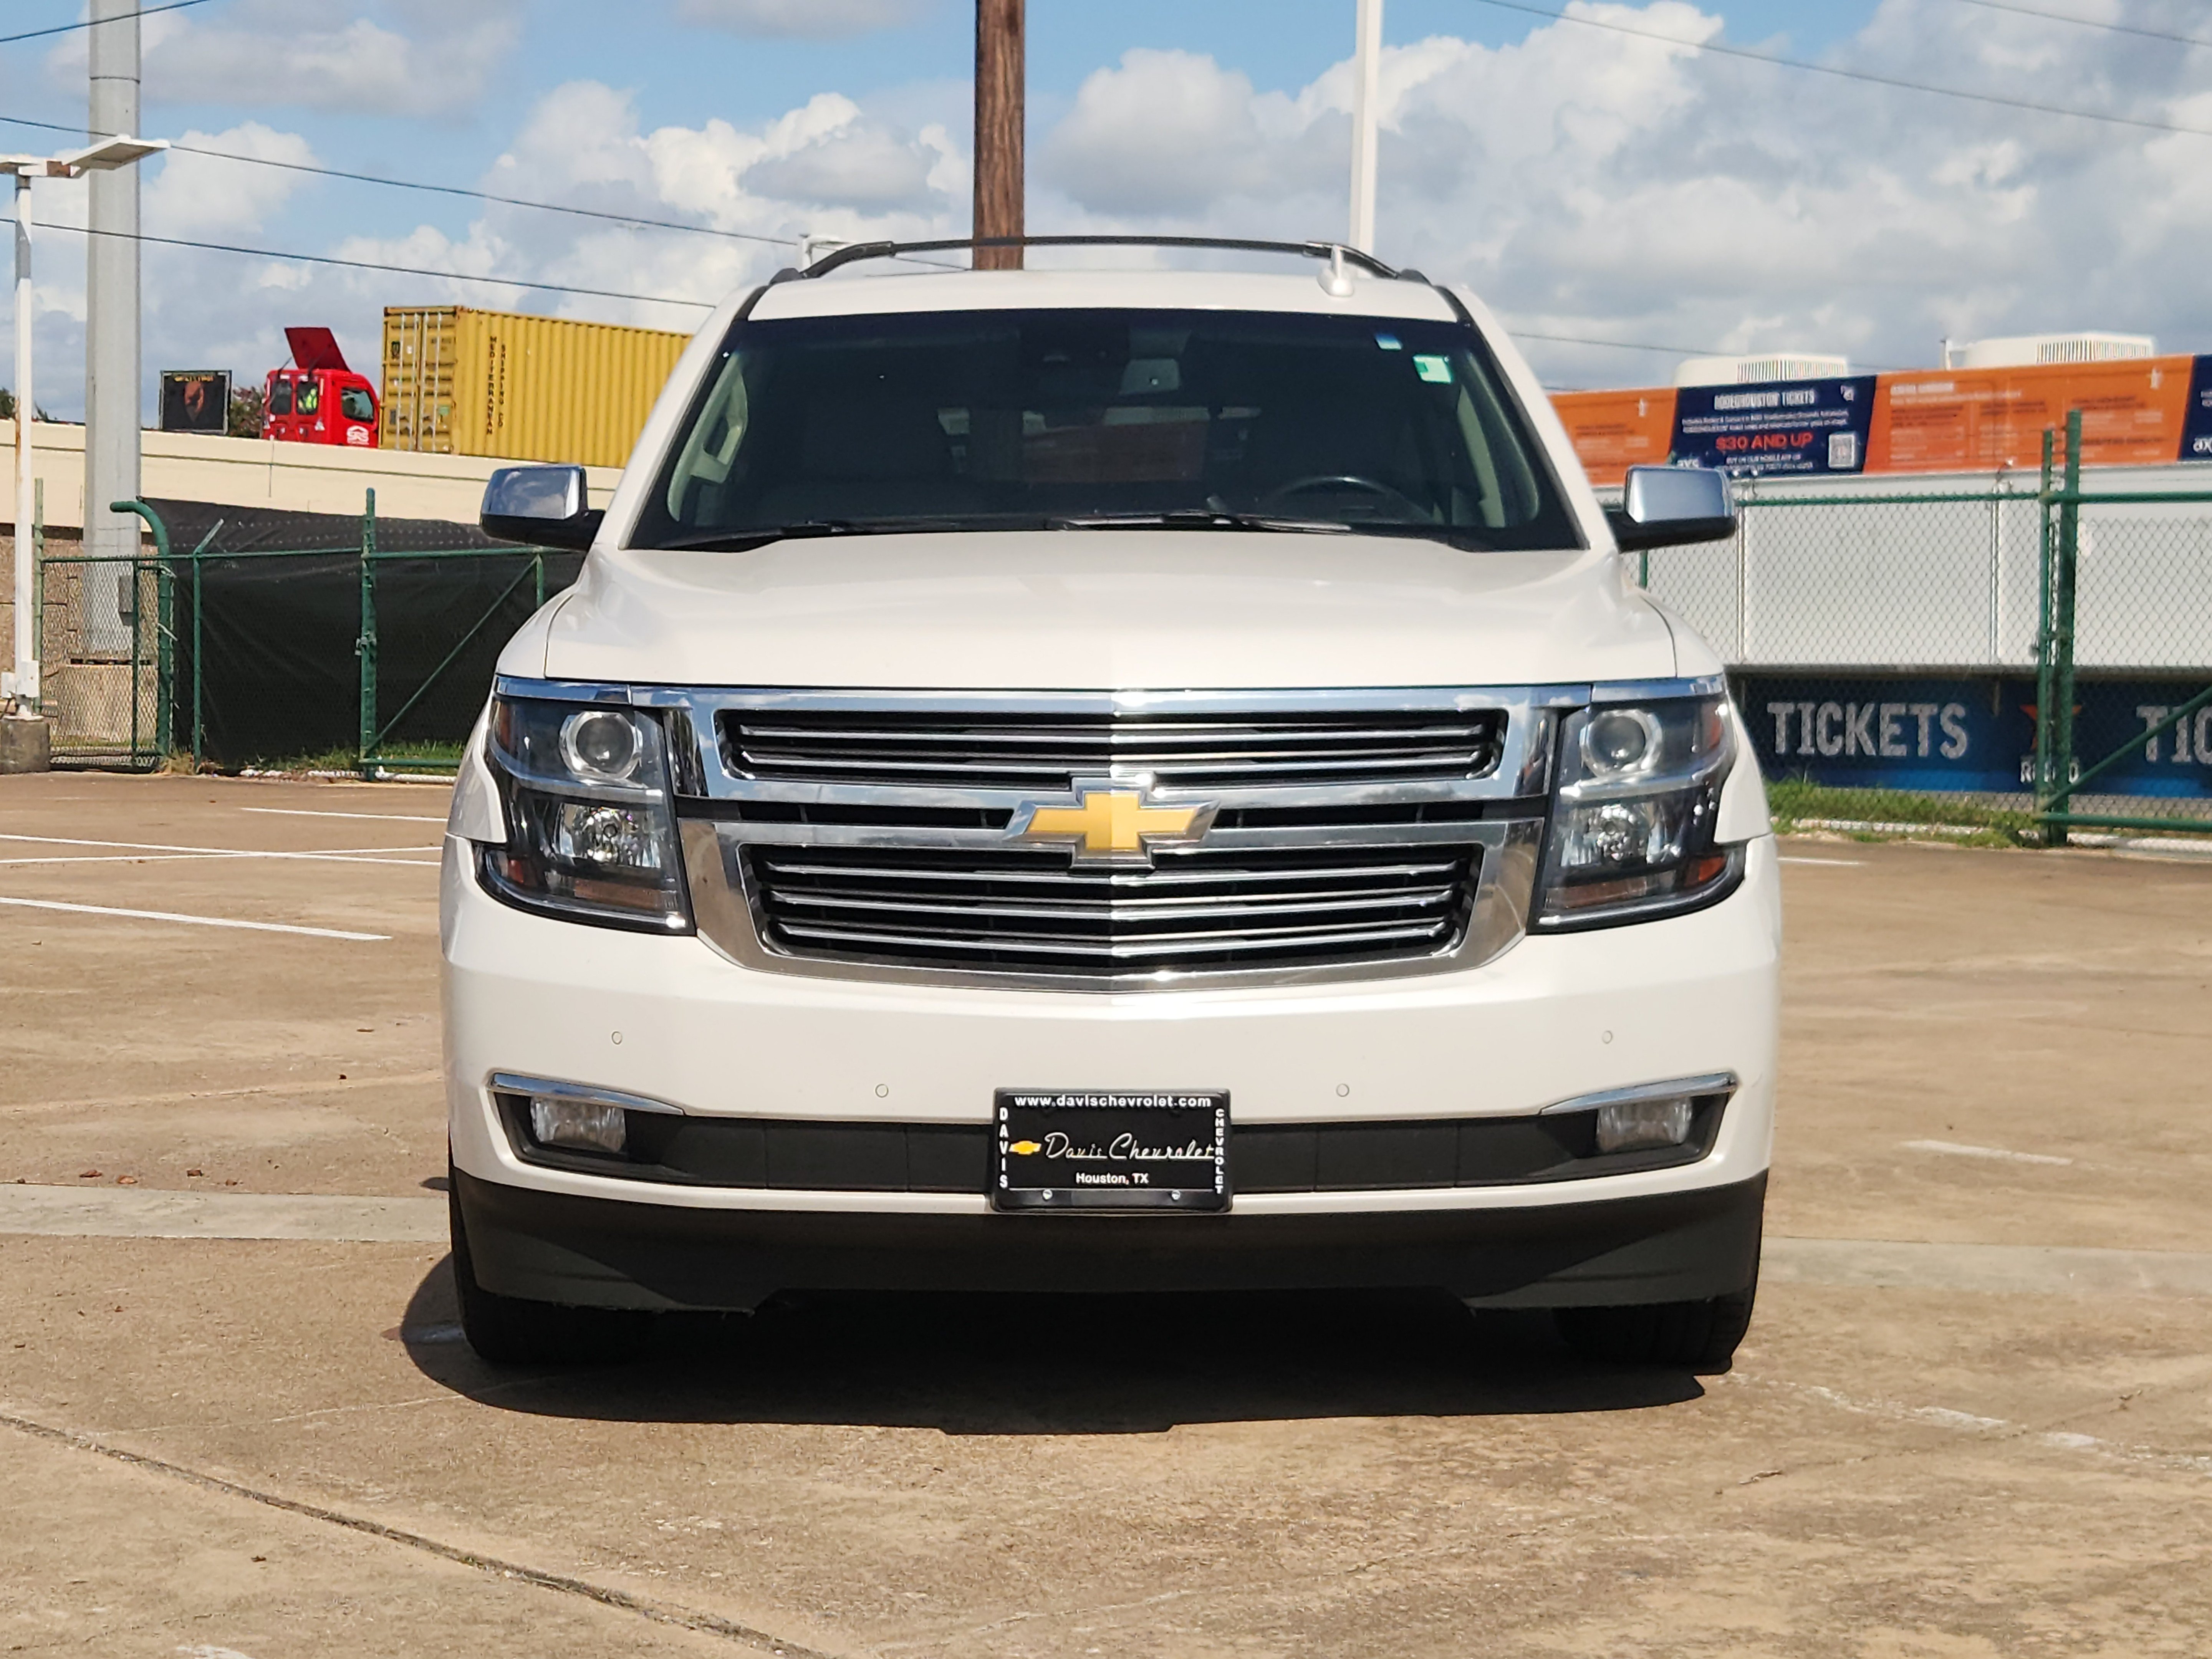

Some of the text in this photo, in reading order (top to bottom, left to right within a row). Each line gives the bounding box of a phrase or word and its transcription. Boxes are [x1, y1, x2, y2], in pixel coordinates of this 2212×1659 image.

[1716, 431, 1813, 450] $30 AND UP
[1767, 702, 1968, 760] TICKETS
[1015, 1094, 1211, 1108] www.davischevrolet.com
[1000, 1107, 1008, 1188] DAVIS
[1044, 1132, 1215, 1159] Davis Chevrolet
[1215, 1109, 1225, 1194] CHEVROLET
[1076, 1172, 1149, 1184] Houston, TX
